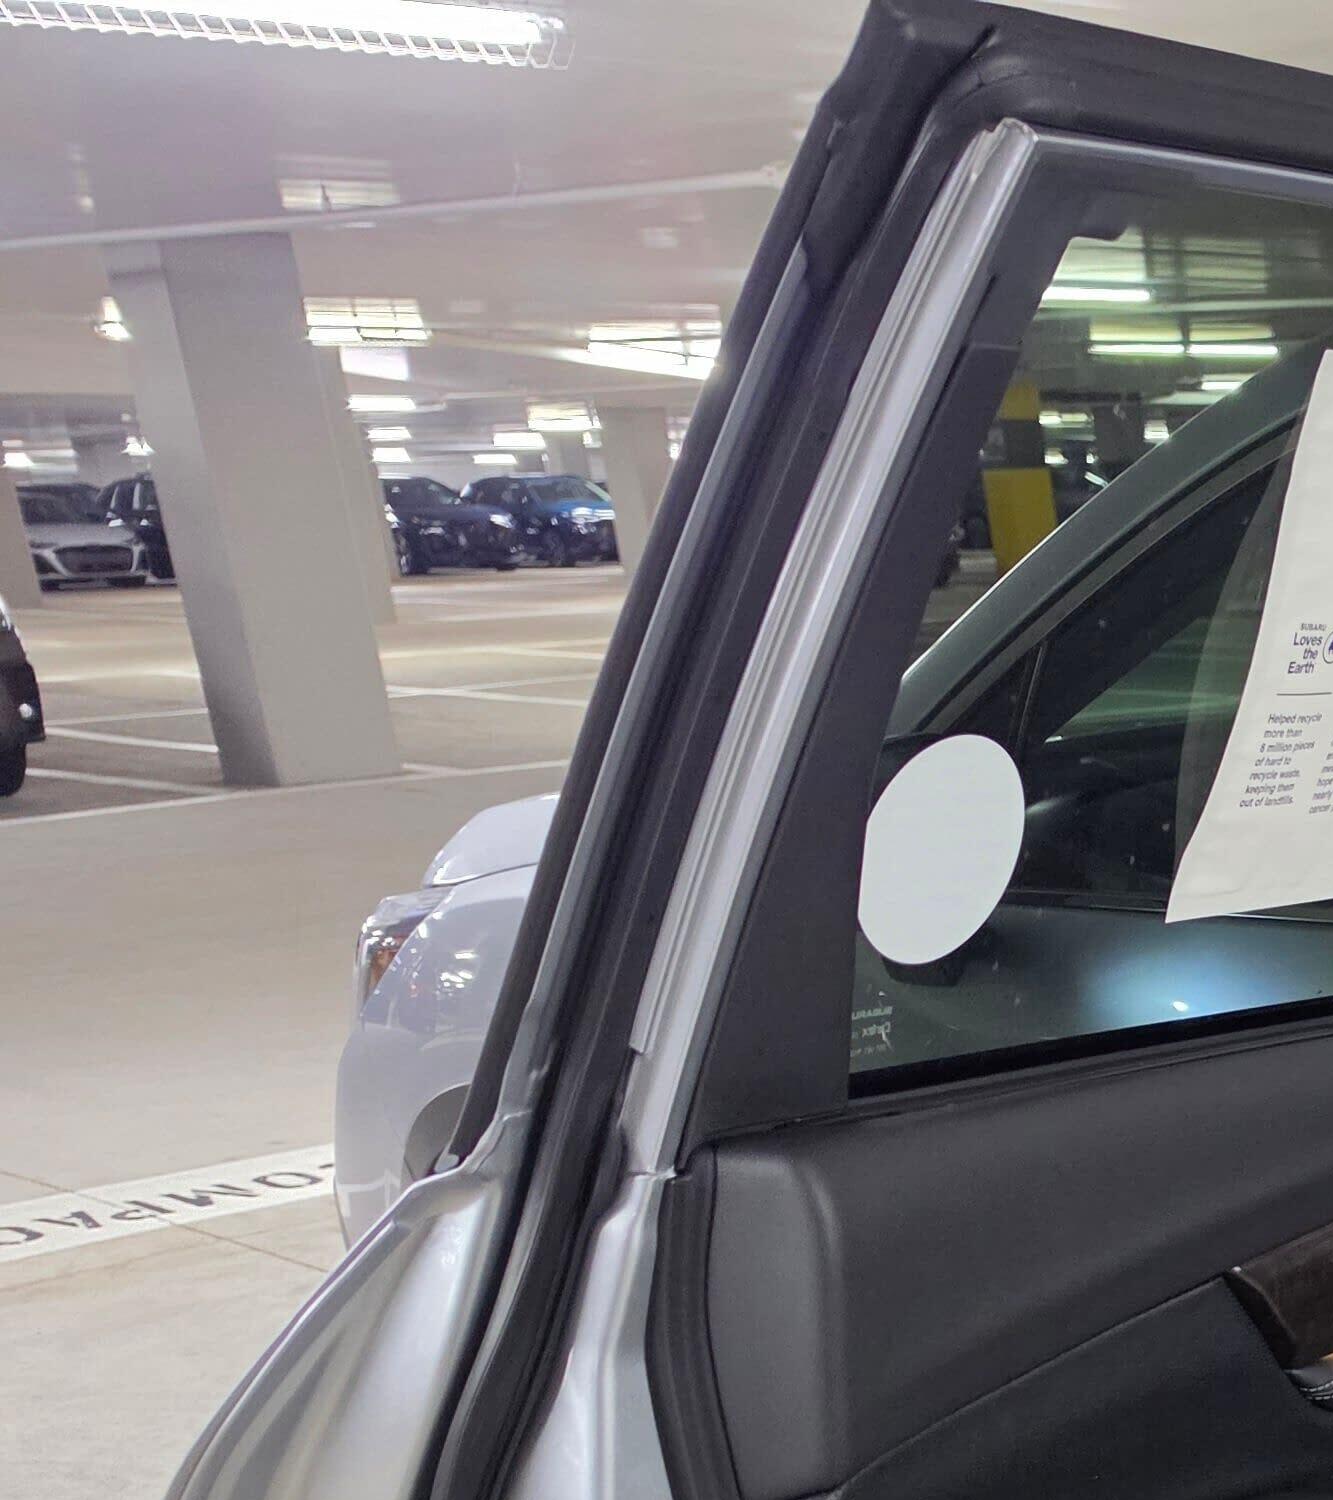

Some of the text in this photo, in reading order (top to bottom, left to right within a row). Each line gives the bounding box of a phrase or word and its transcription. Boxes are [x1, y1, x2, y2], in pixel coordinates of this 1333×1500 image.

[1300, 623, 1327, 632] SUBARU
[1293, 632, 1323, 646] Loves
[1302, 648, 1319, 660] the
[1287, 661, 1315, 675] Earth
[1268, 712, 1322, 725] Helped recycle
[1263, 729, 1303, 738] more than
[1266, 742, 1292, 752] million
[1255, 756, 1265, 766] of
[1245, 783, 1276, 795] keeping
[1240, 798, 1254, 807] out
[1254, 797, 1264, 807] of
[0, 1162, 334, 1246] OMPAC
